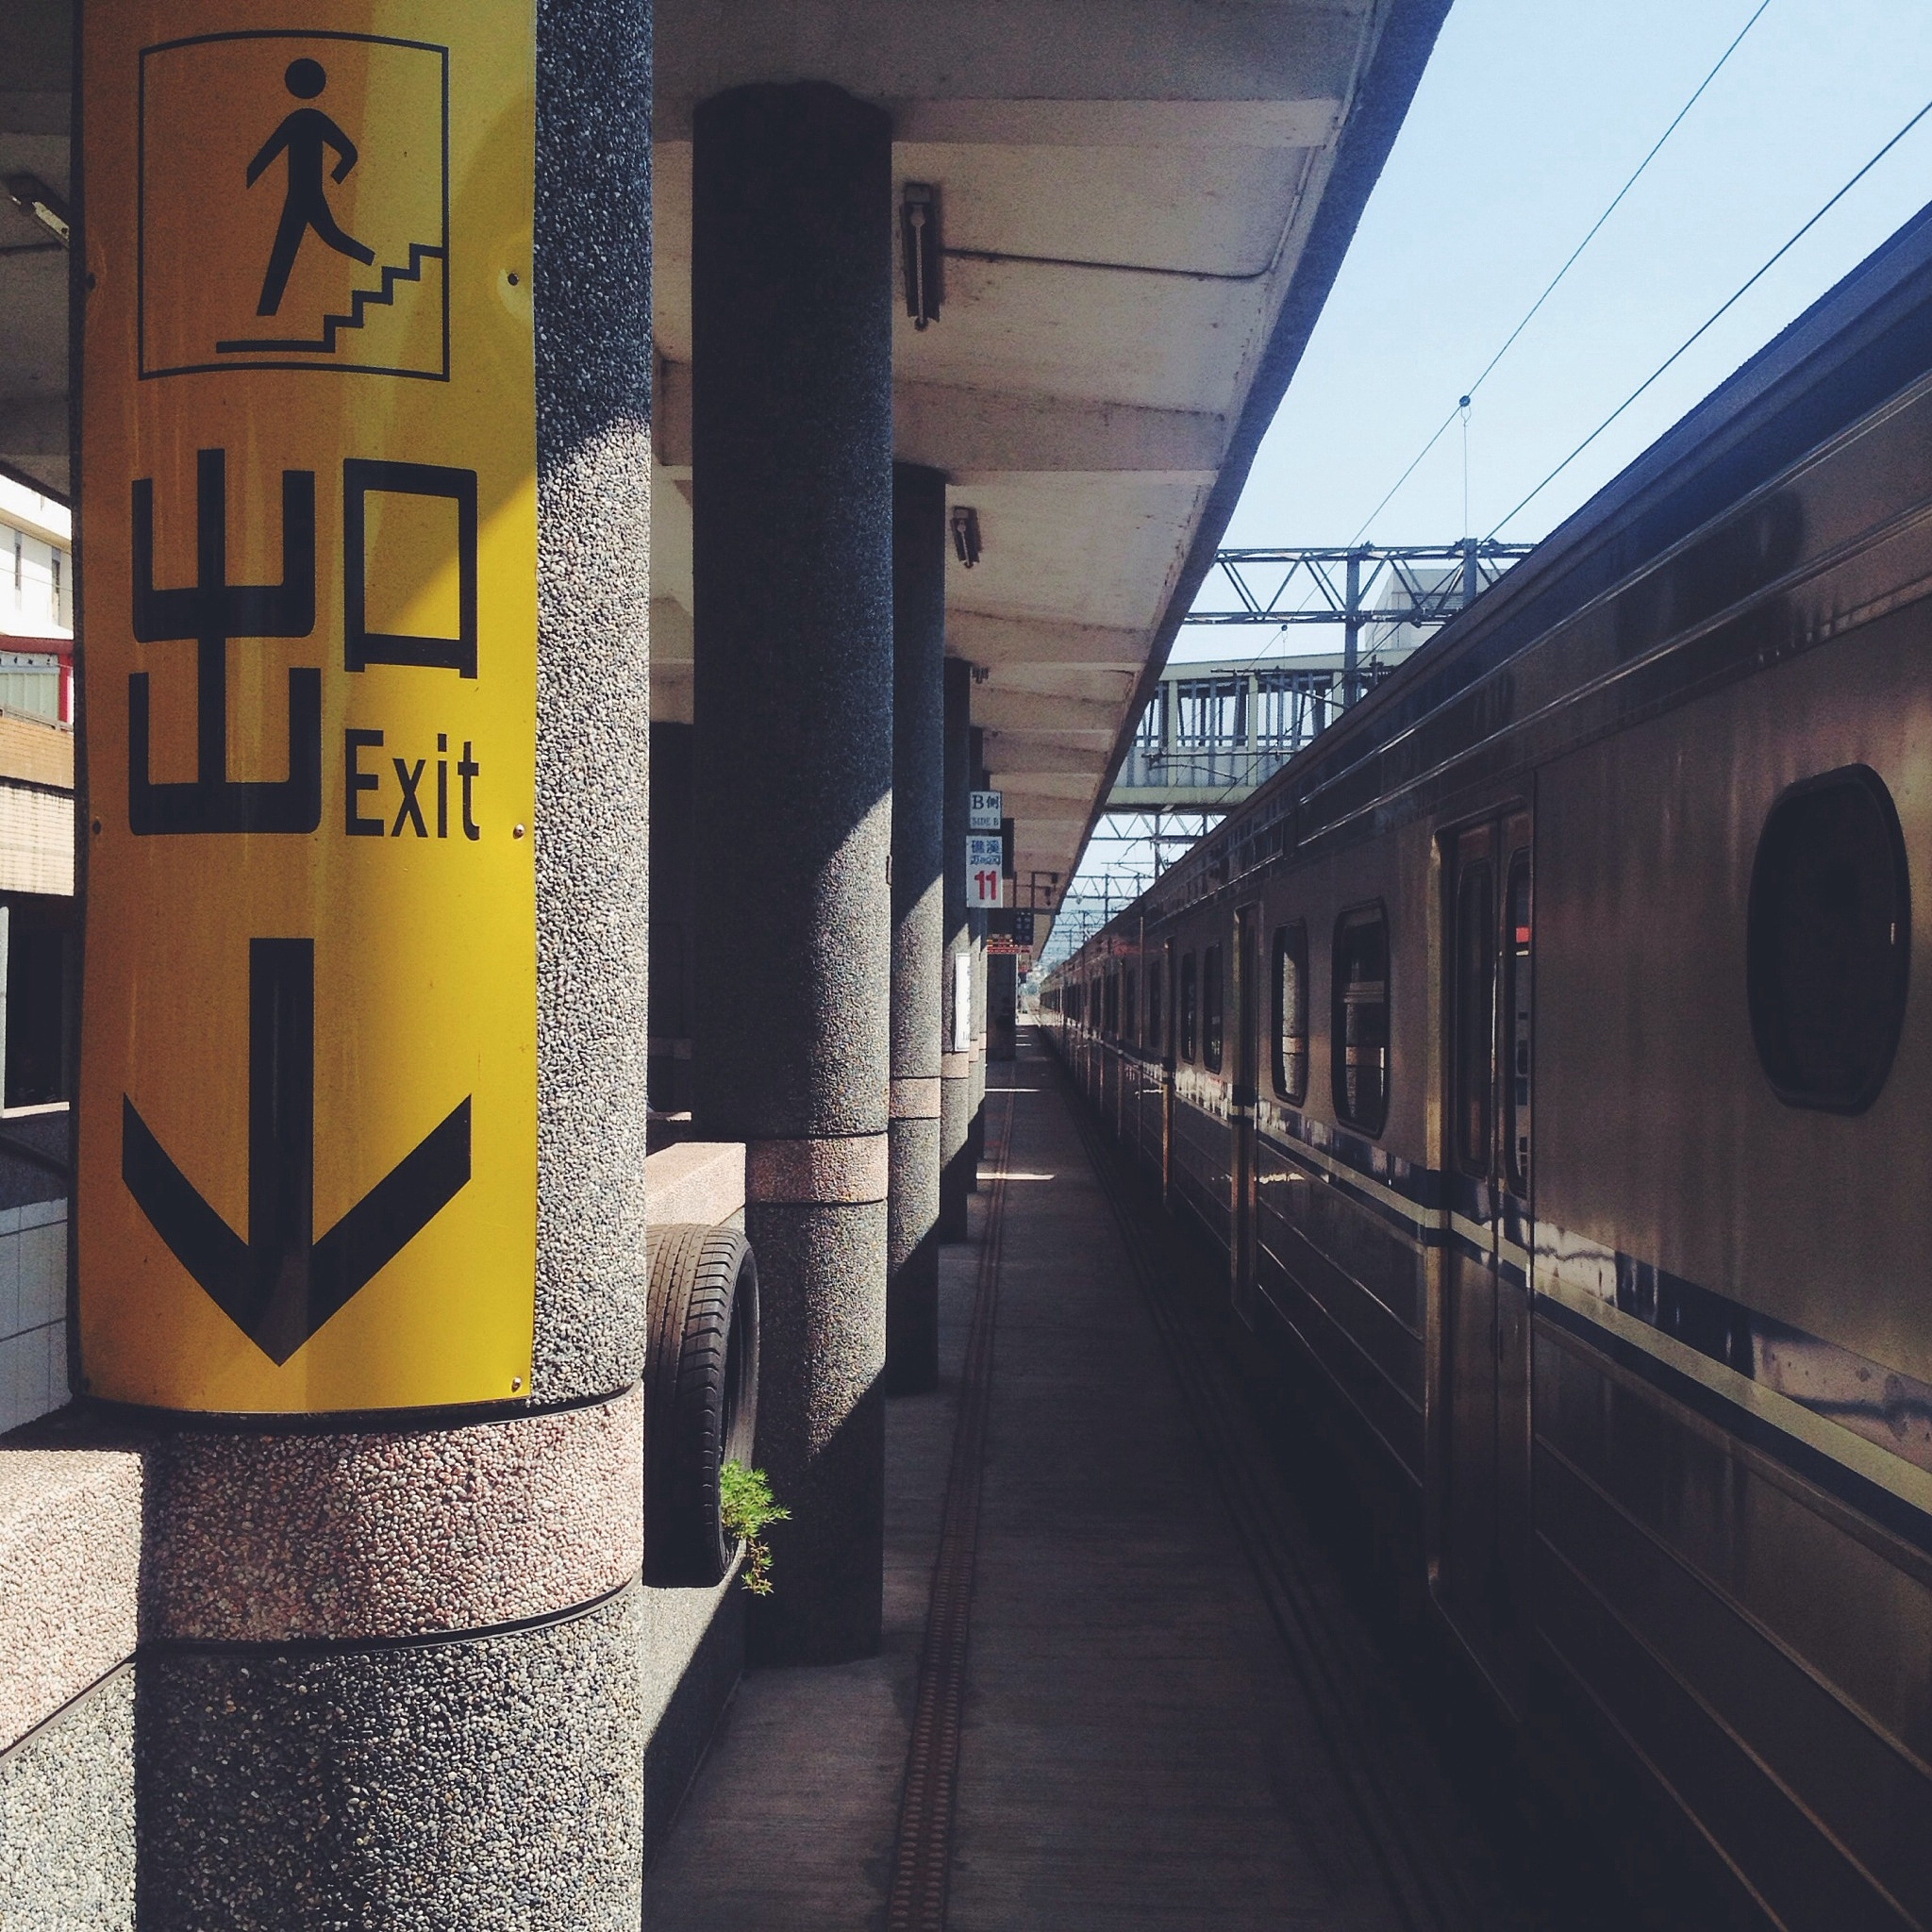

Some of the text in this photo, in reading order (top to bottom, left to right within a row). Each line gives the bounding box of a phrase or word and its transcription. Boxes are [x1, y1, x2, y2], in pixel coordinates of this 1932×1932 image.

[128, 448, 478, 836] 出口
[344, 728, 480, 841] Exit
[972, 817, 999, 826] SIDE B
[974, 870, 998, 901] 11
